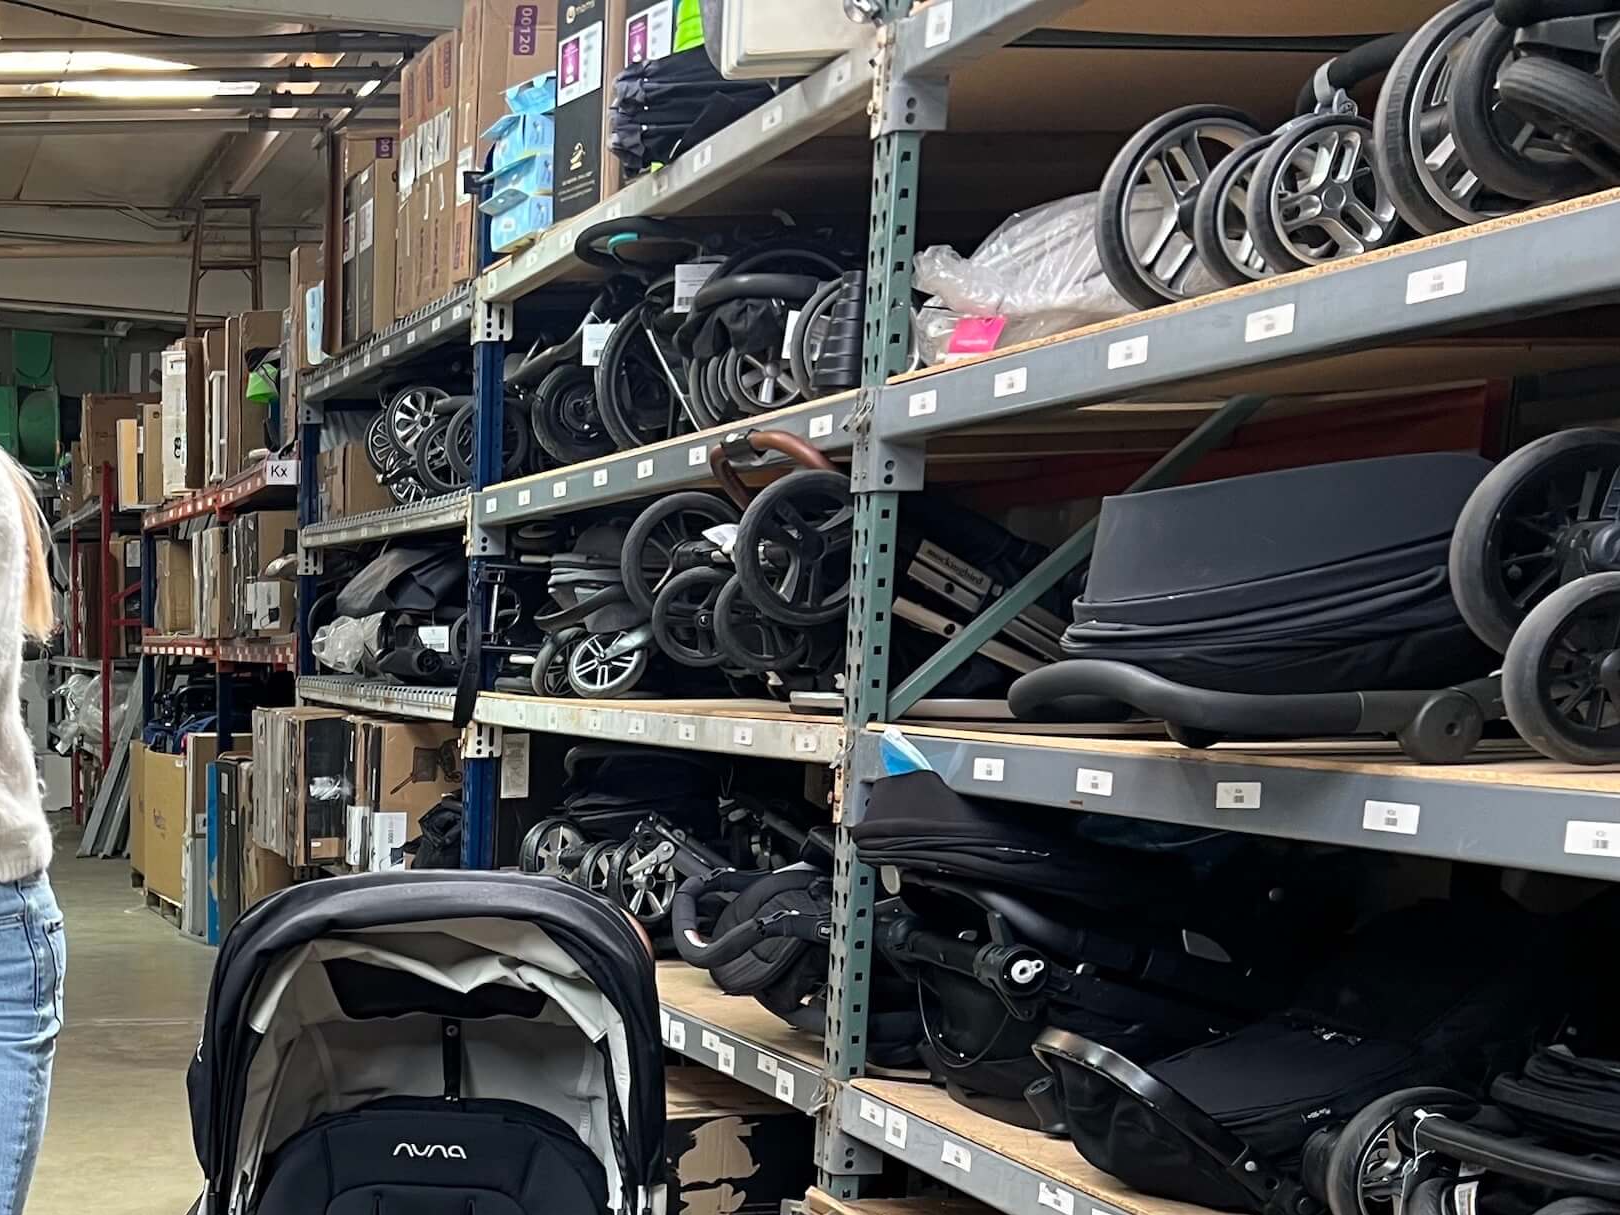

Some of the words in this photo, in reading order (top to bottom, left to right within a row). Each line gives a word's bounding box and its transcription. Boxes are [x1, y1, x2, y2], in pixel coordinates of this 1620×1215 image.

[518, 7, 533, 54] 00120
[270, 465, 288, 478] Kx
[393, 1141, 468, 1160] nuna
